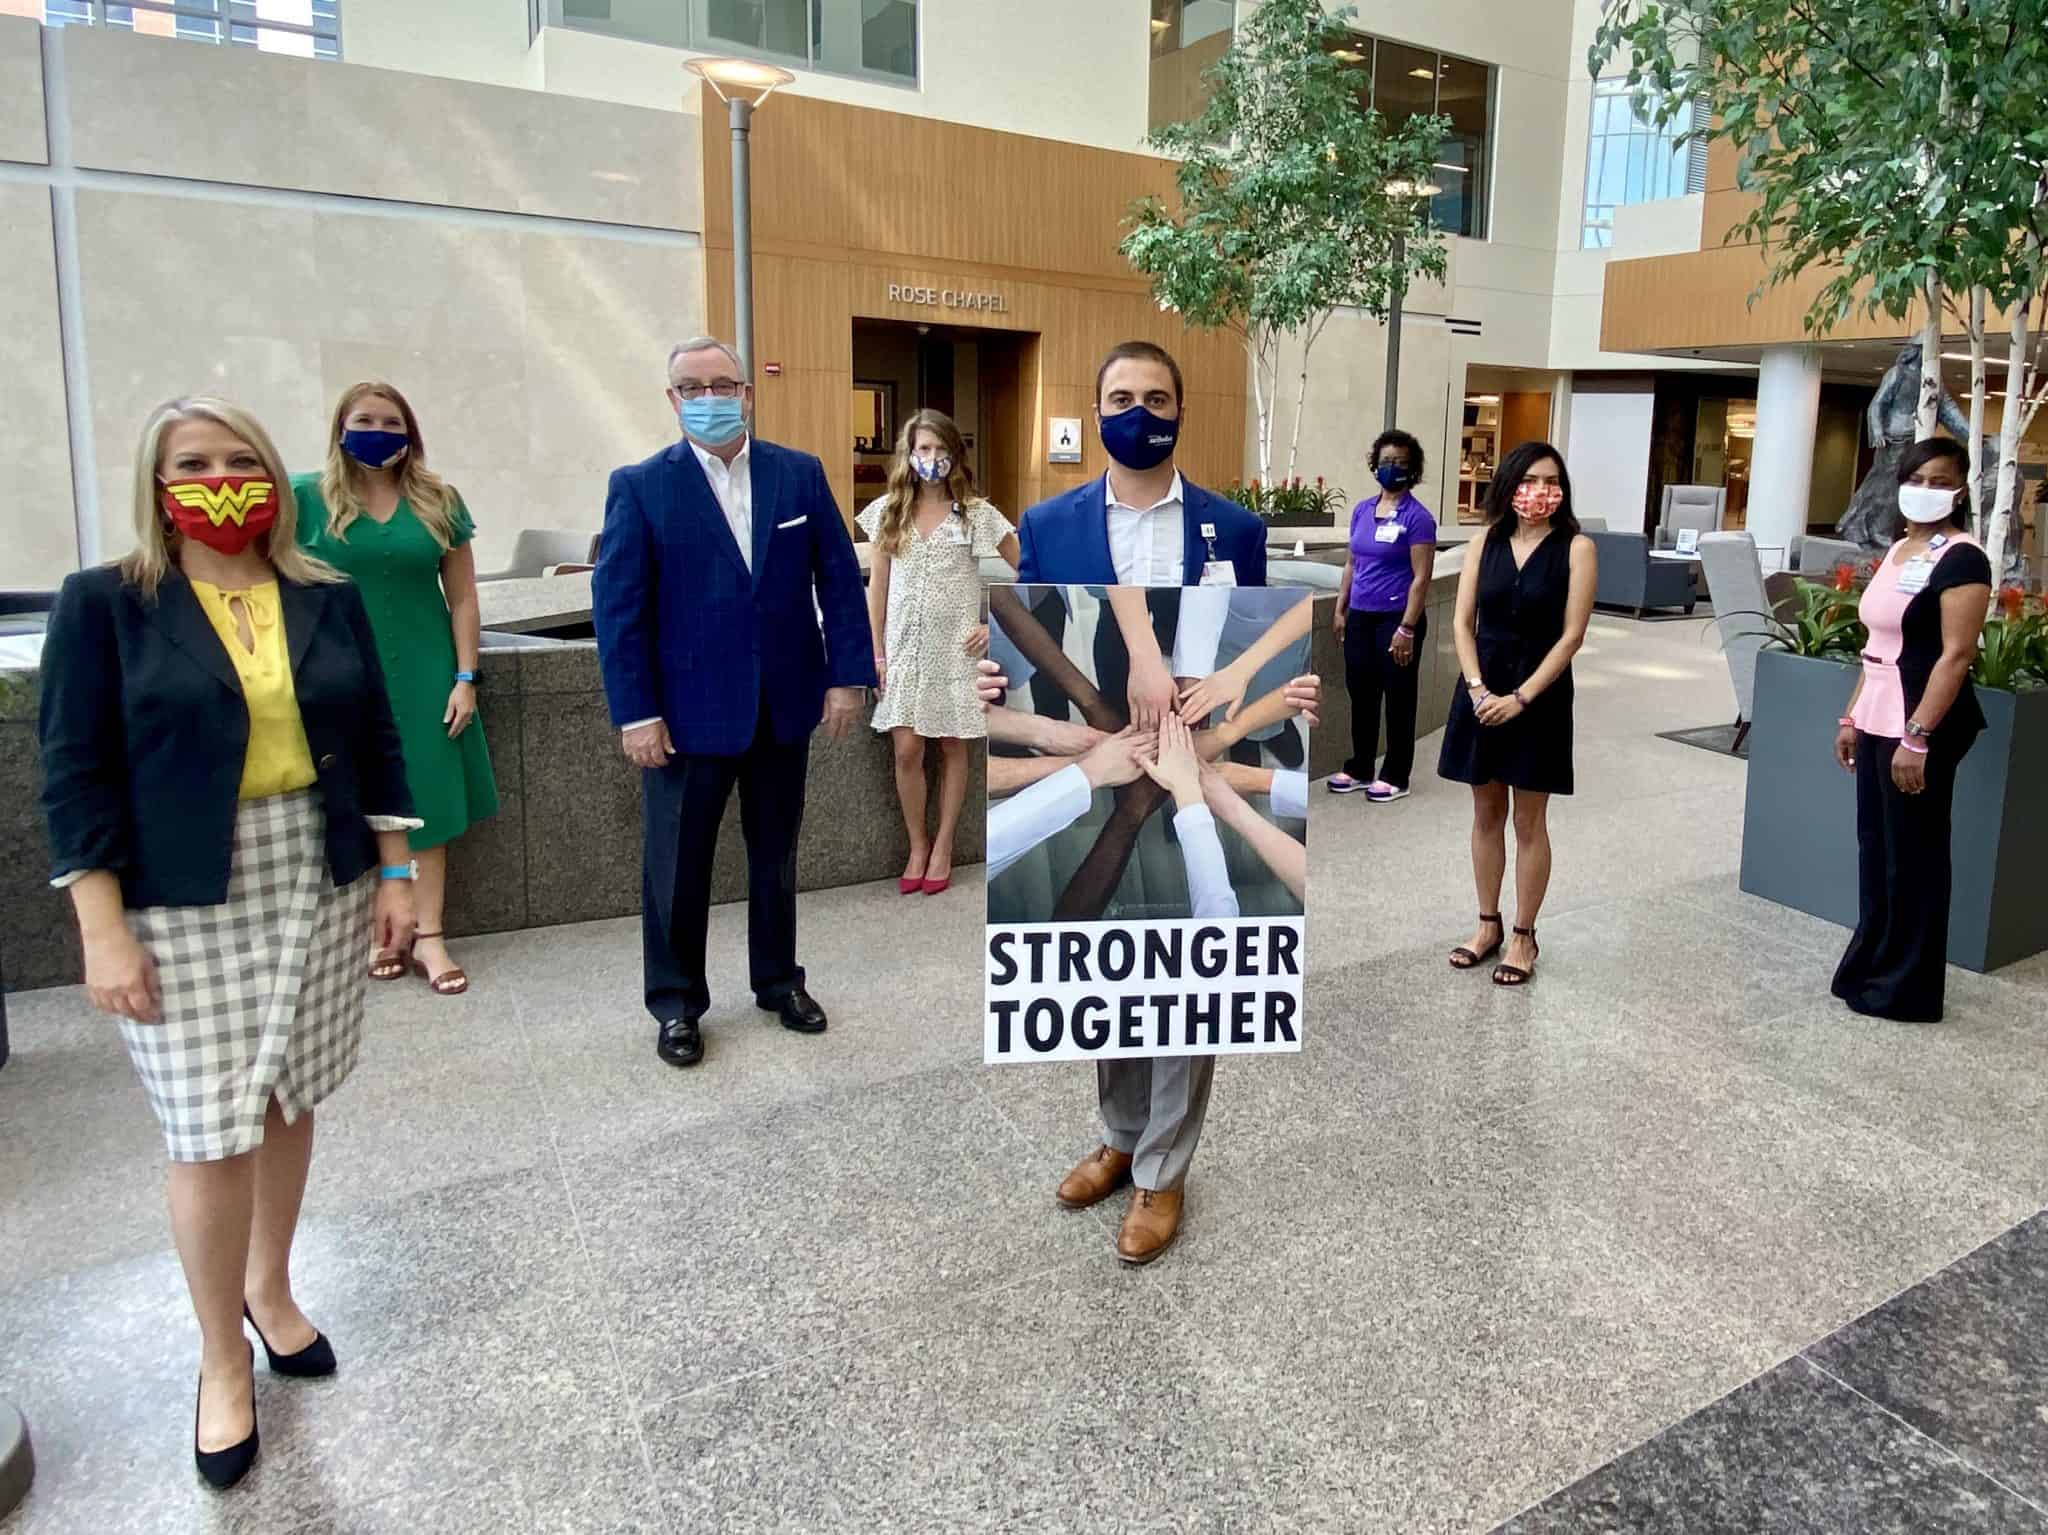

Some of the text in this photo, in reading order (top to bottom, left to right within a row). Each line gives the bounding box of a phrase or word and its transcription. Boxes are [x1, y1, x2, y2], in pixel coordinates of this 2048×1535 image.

[888, 284, 1008, 312] ROSE CHAPEL
[989, 925, 1299, 986] STRONGER
[990, 991, 1297, 1053] TOGETHER
